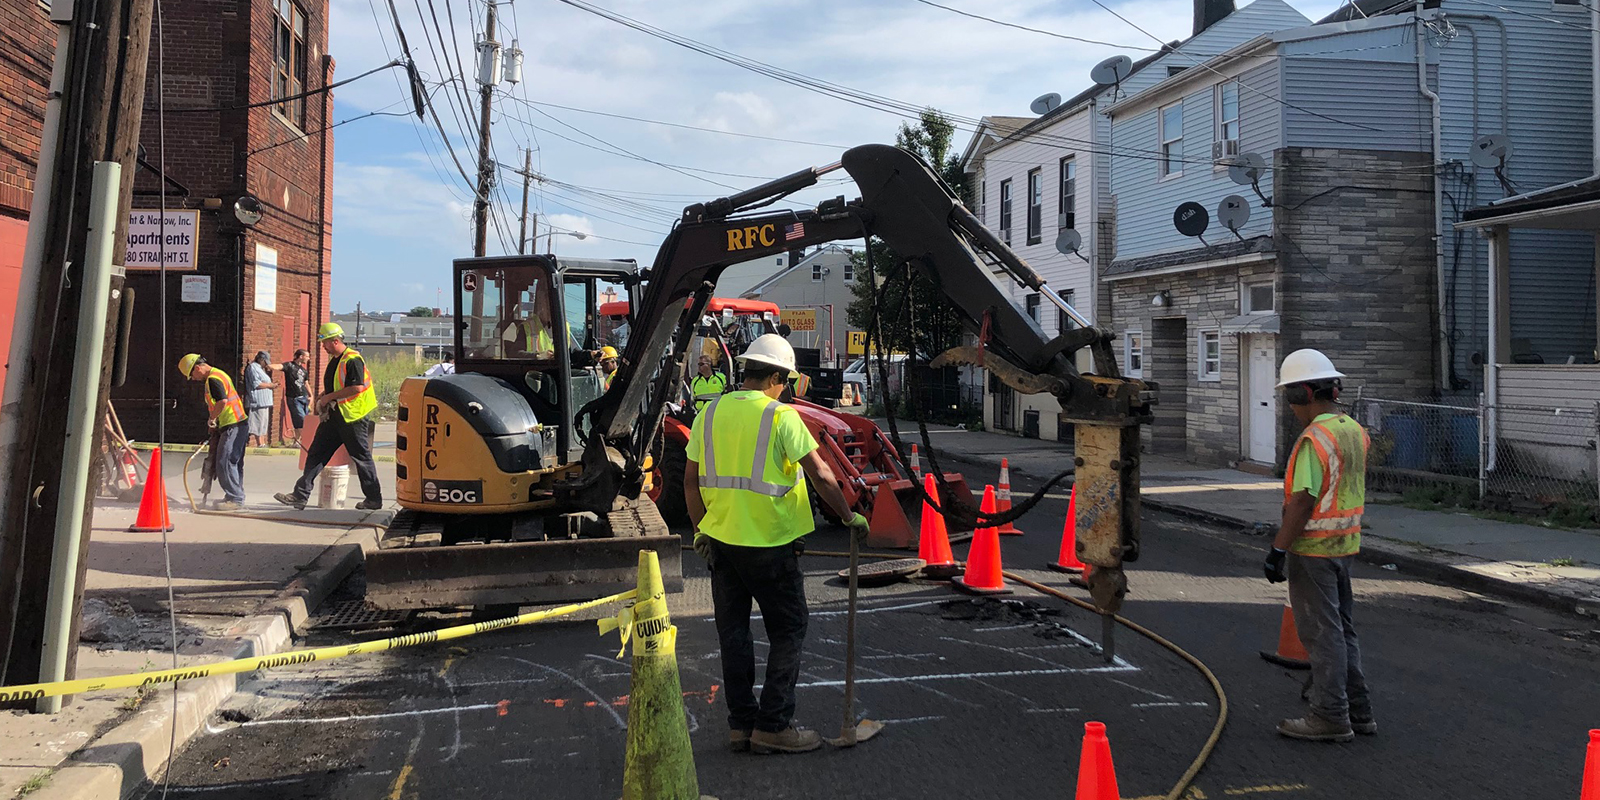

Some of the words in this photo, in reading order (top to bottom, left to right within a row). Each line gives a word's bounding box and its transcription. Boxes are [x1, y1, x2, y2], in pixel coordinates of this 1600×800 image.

[139, 214, 145, 225] &
[147, 215, 176, 227] Narow,
[178, 215, 192, 226] Inc.
[1181, 208, 1197, 221] dish
[726, 223, 776, 251] RFC
[125, 251, 137, 263] 80
[425, 404, 440, 471] RFC
[439, 489, 476, 503] 50G
[636, 615, 671, 639] CUIDA
[141, 670, 209, 686] CAUTION
